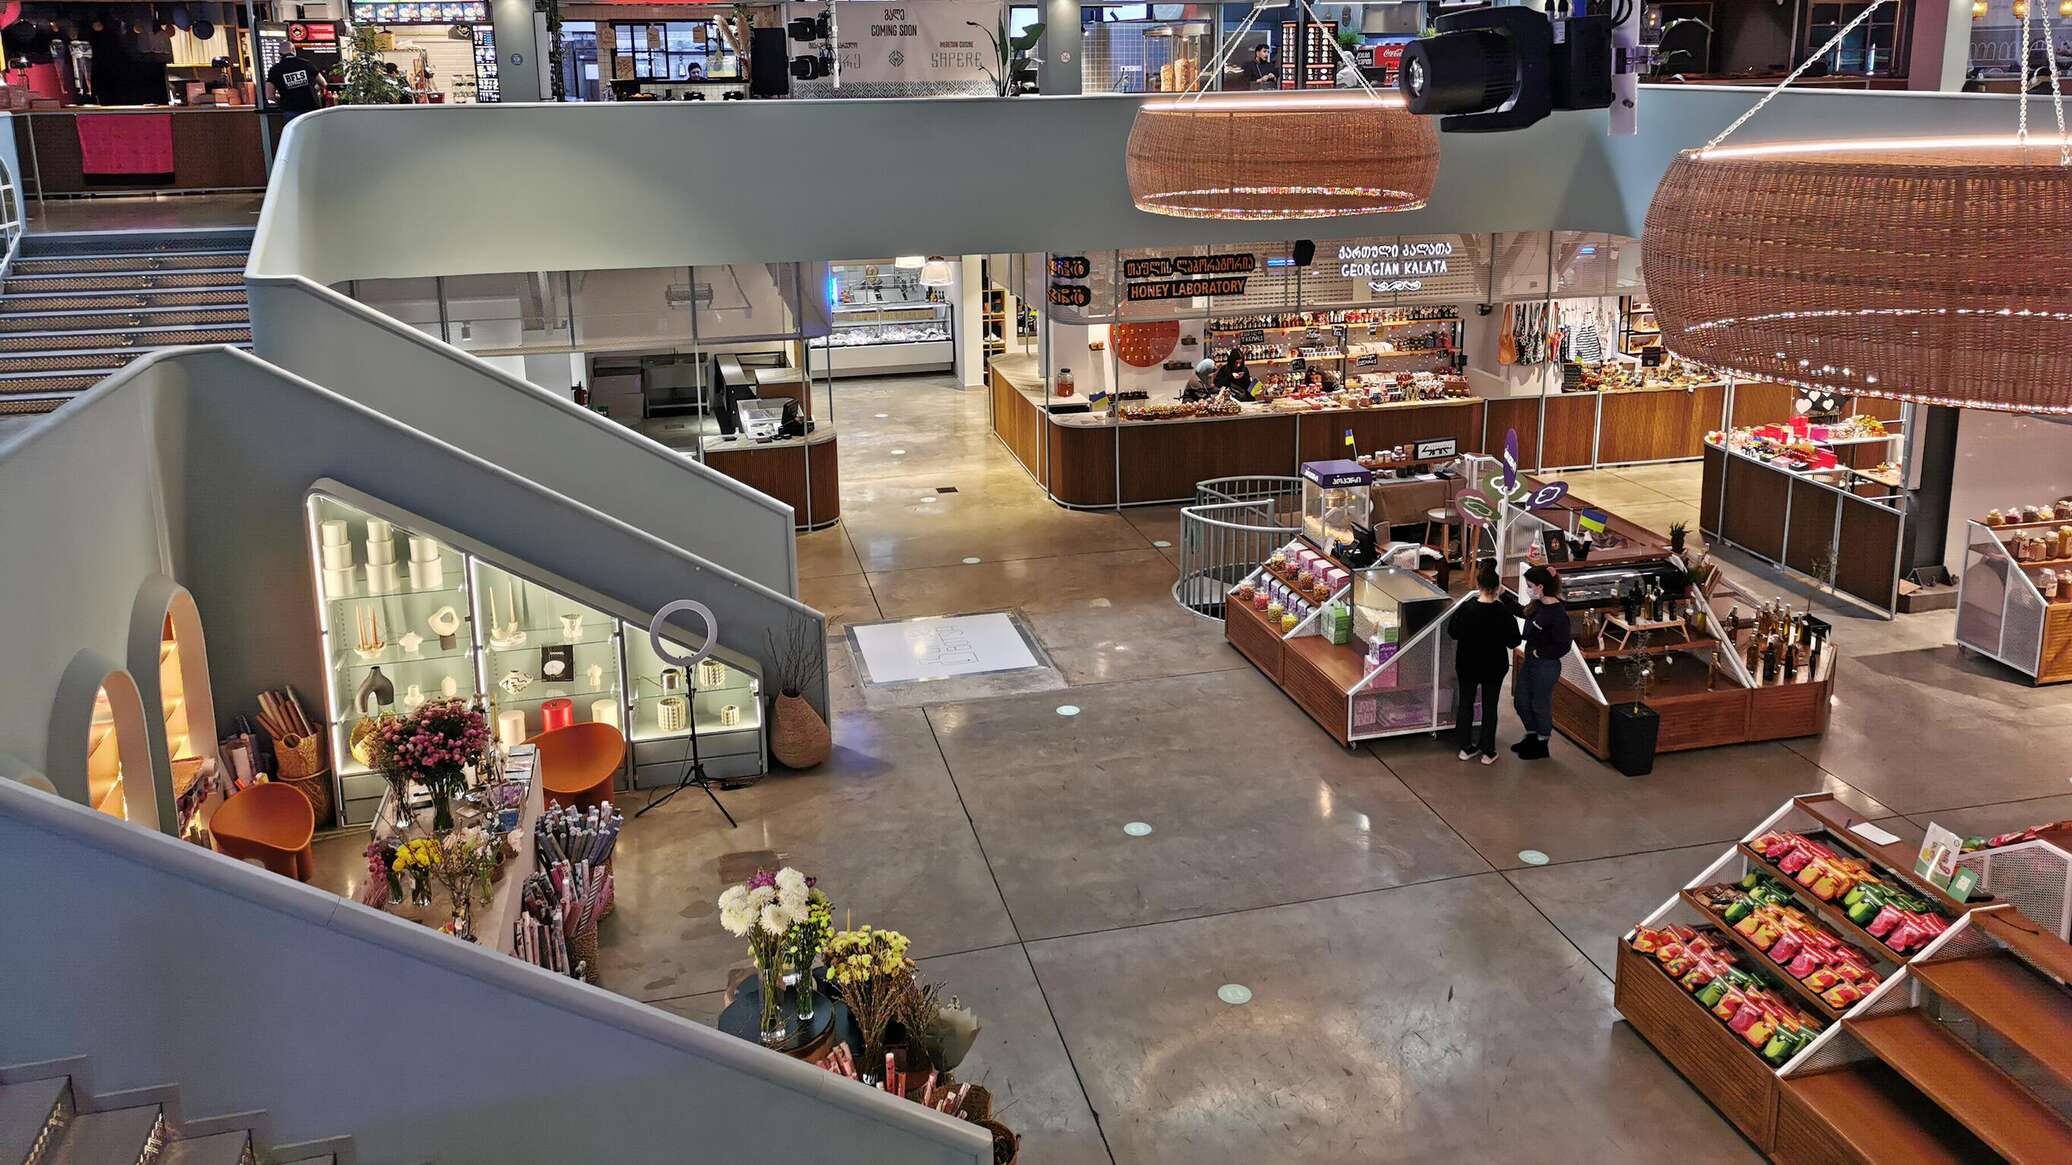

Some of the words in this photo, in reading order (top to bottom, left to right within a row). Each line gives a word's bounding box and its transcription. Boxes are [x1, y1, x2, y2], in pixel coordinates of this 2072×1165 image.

[871, 24, 898, 37] COMING
[899, 24, 917, 37] SOON
[931, 51, 982, 68] SAPERE
[1338, 244, 1399, 260] ქართული
[1341, 261, 1399, 277] GEORGIAN
[1404, 260, 1448, 275] KALATA
[1131, 284, 1170, 299] HONEY
[1172, 280, 1245, 297] LABORATORY
